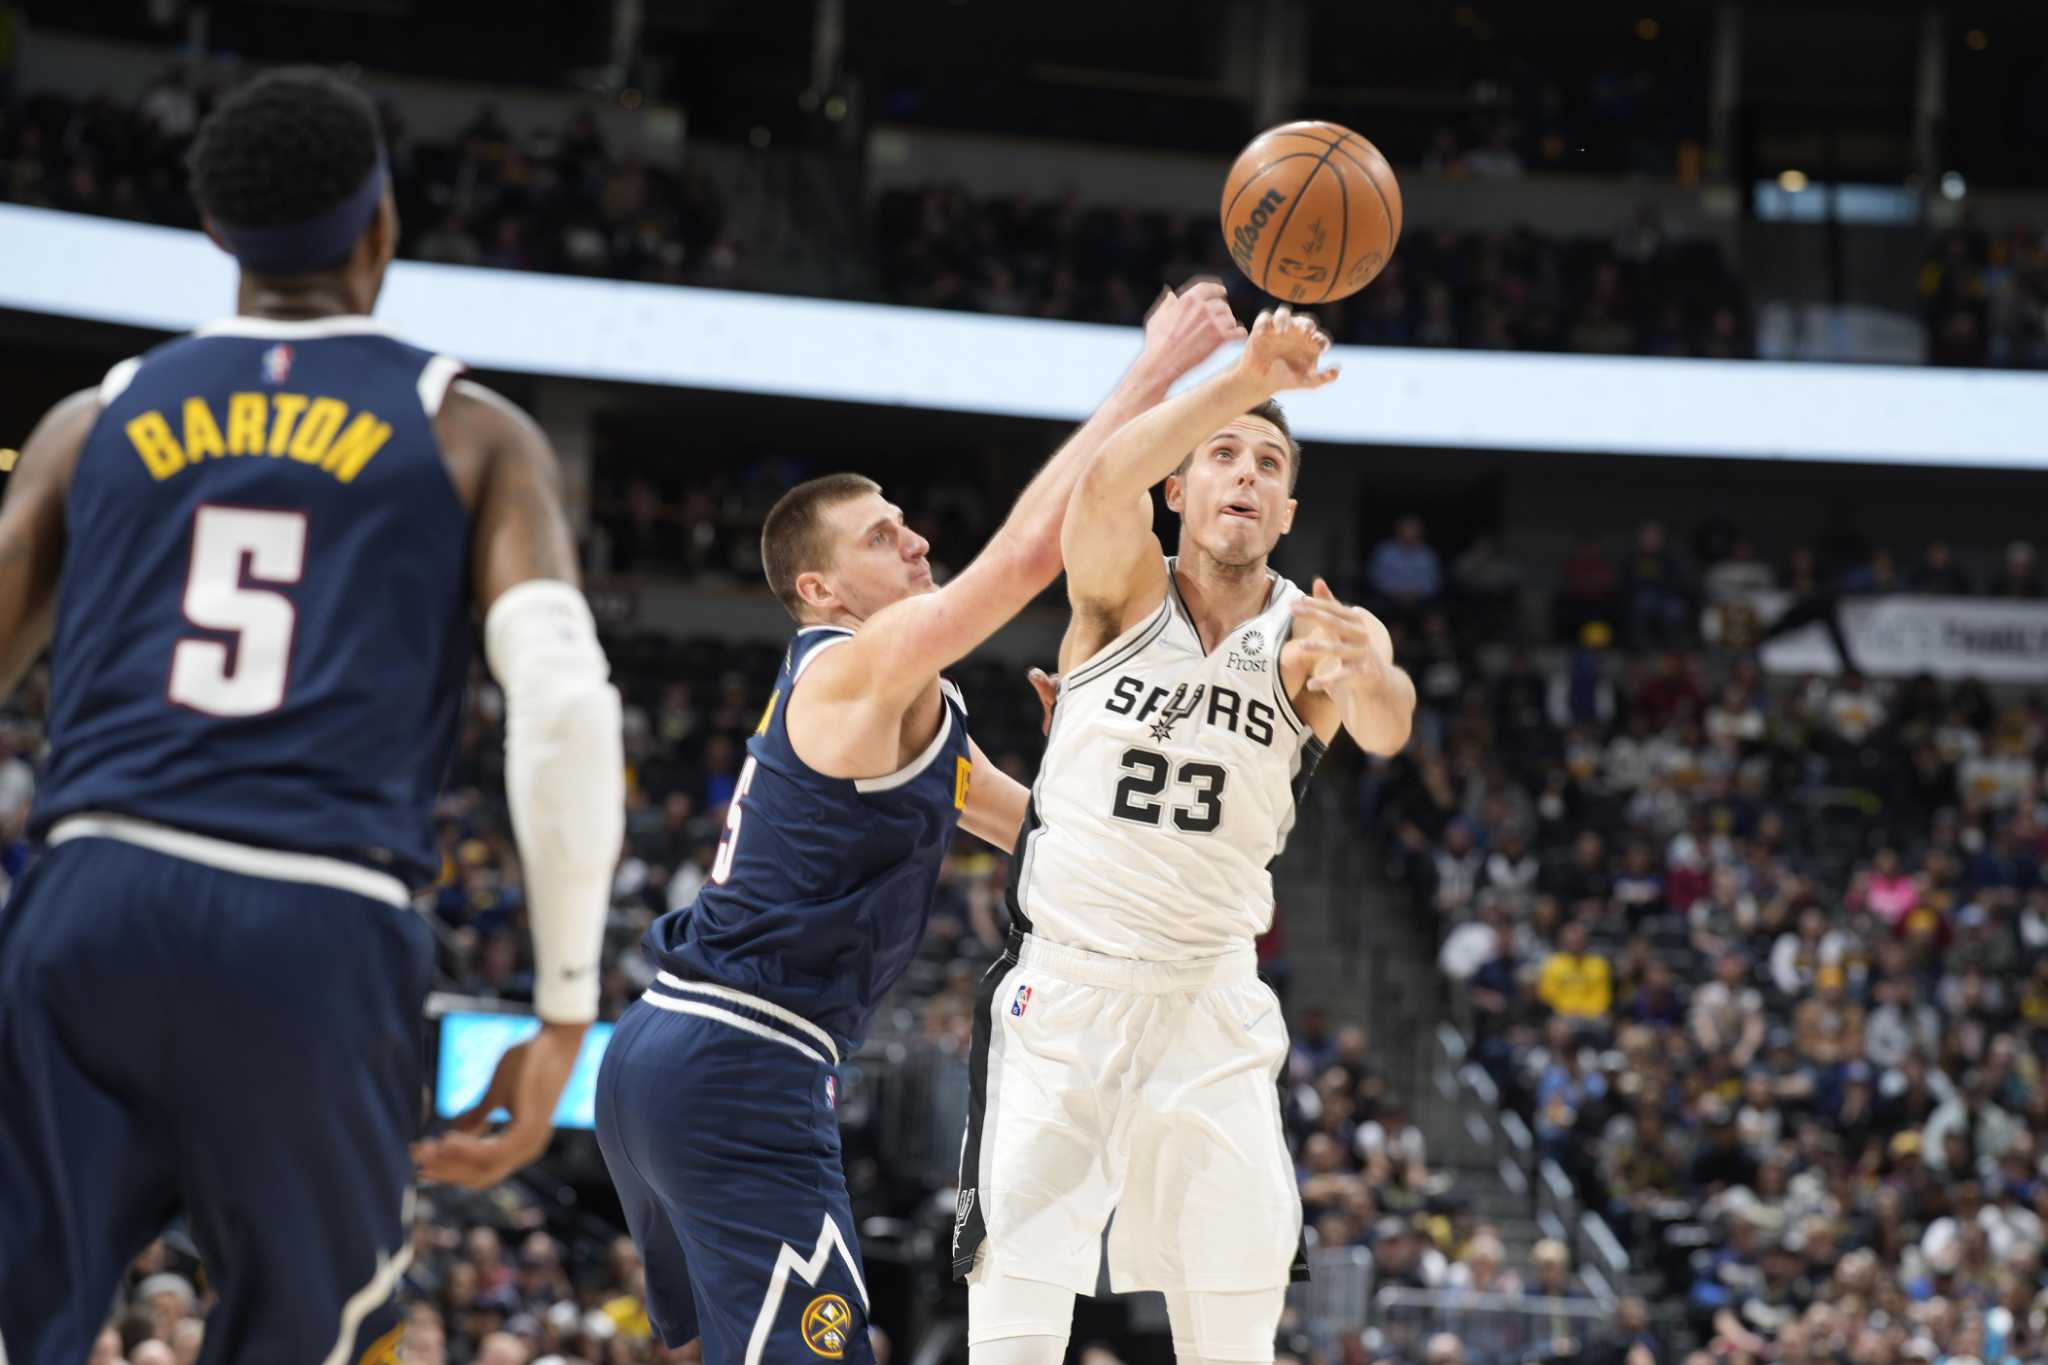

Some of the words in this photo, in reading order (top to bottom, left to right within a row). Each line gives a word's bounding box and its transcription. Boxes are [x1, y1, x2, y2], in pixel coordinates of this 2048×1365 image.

[125, 391, 393, 483] BARTON
[168, 504, 307, 718] 5
[1226, 651, 1268, 673] Frost
[1104, 675, 1275, 747] SPURS
[1110, 745, 1230, 835] 23
